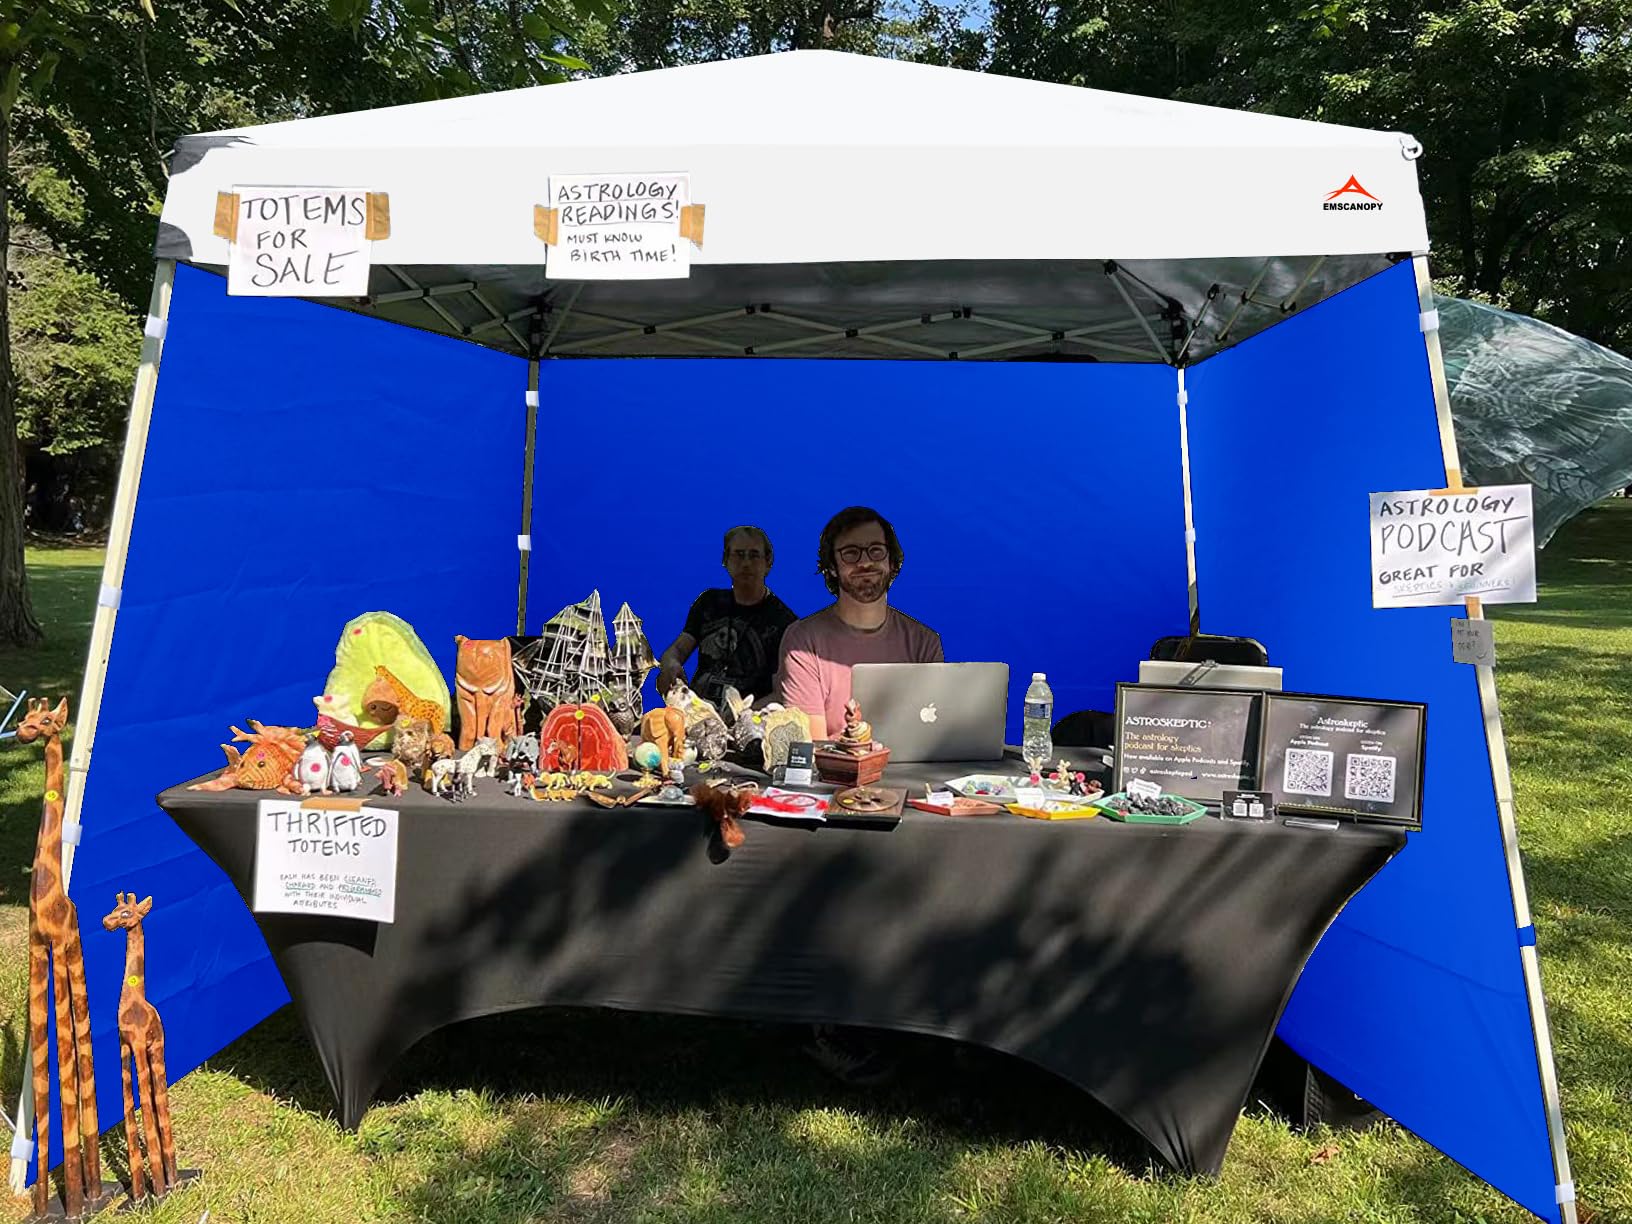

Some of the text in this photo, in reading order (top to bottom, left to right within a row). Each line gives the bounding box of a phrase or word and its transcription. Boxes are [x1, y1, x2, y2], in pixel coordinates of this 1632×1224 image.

[558, 182, 677, 202] ASTROLOGY
[242, 195, 365, 226] TOTEMS
[562, 200, 679, 225] READINGS!
[257, 228, 307, 249] FOR
[567, 232, 643, 244] MUST KNOW
[571, 244, 676, 262] BIRTH TIME!
[251, 251, 359, 287] SALE
[1380, 496, 1514, 516] ASTROLOGY
[1381, 516, 1528, 556] PODCAST
[1379, 563, 1484, 584] GREAT FOR
[1125, 716, 1212, 729] ASTROSKEPTIC:
[1125, 732, 1179, 743] The astrology
[1124, 743, 1202, 753] podcast for skeptics
[267, 809, 386, 838] THRIFTED
[288, 839, 360, 856] TOTEMS
[320, 874, 339, 882] BEEN
